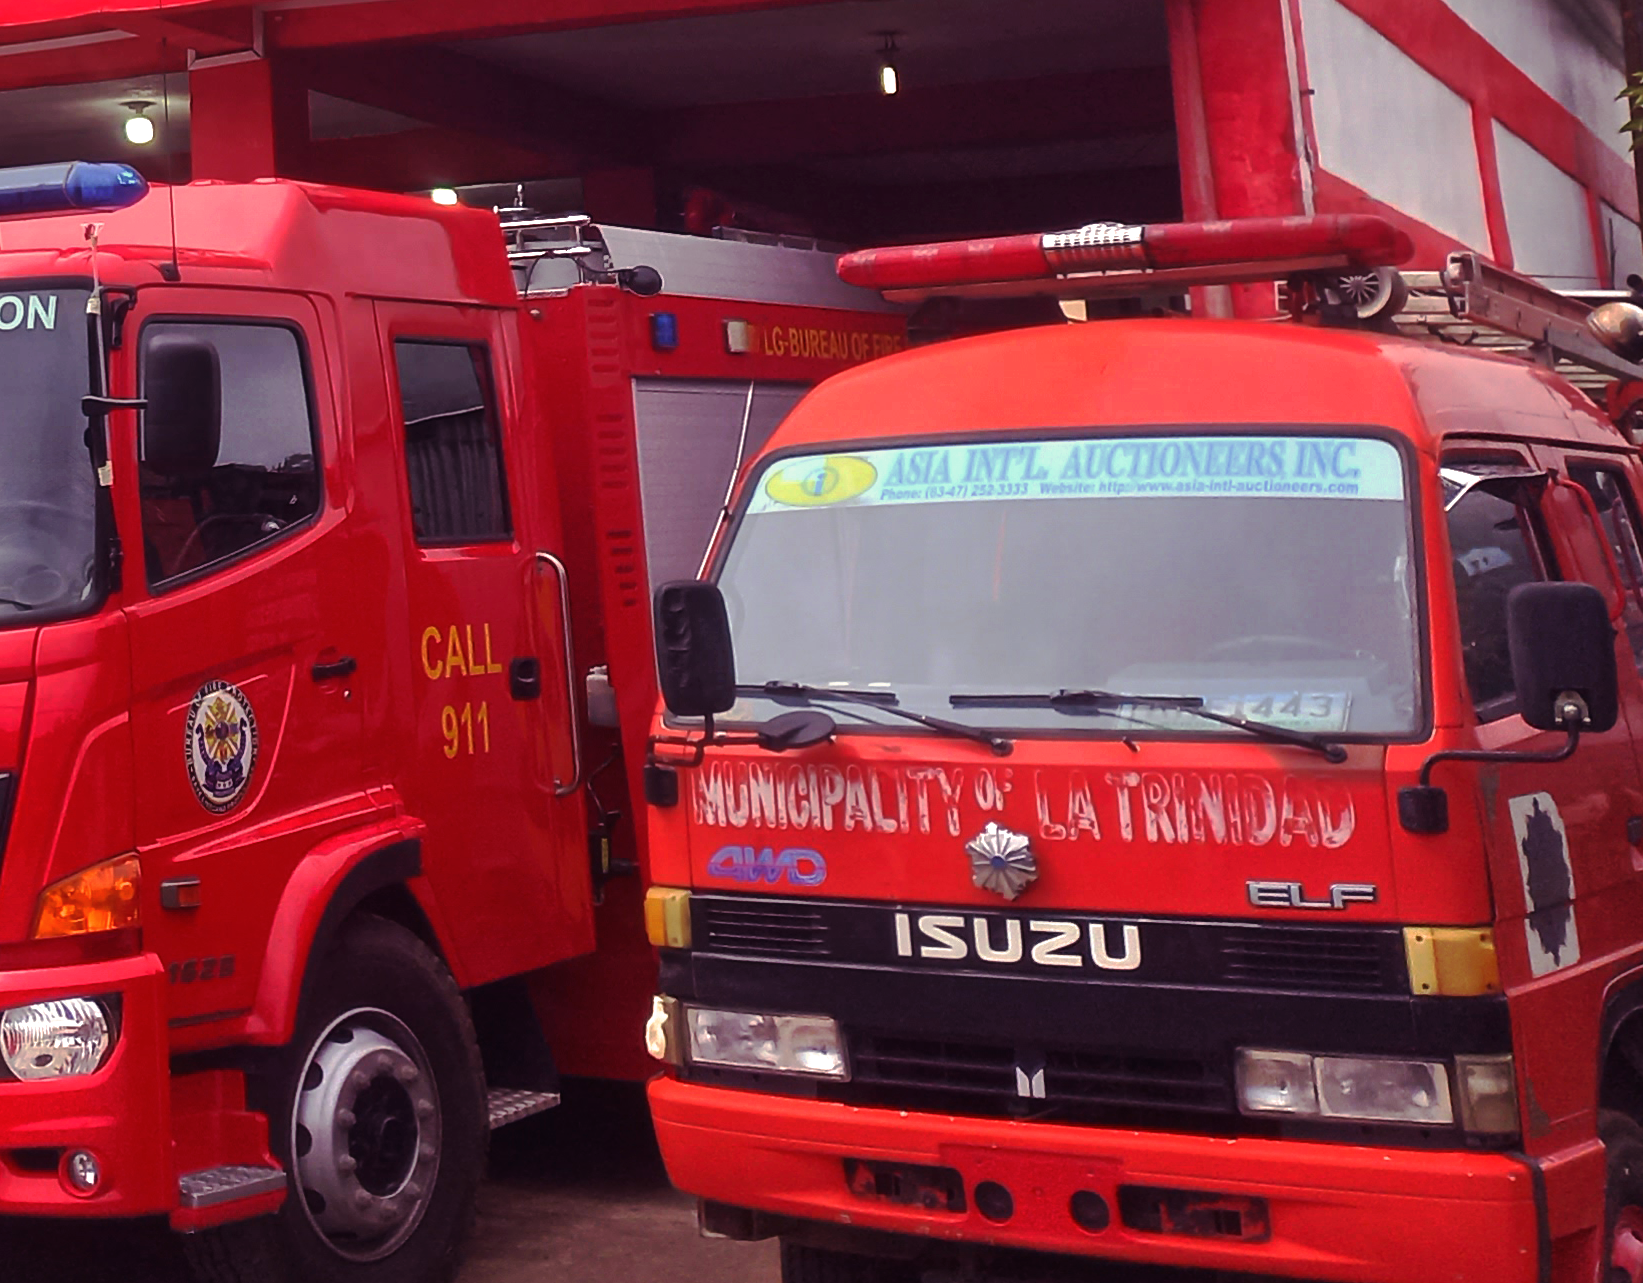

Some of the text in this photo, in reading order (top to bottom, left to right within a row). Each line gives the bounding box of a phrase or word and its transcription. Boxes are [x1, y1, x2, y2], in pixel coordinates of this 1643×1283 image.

[851, 332, 869, 361] OF
[883, 450, 953, 486] ASIA
[1060, 440, 1288, 480] AUCTIONEERS
[880, 488, 922, 501] Phone:
[421, 623, 502, 680] CALL
[442, 701, 489, 759] 911
[691, 761, 964, 836] MUNICIPALITY
[1035, 769, 1101, 841] LA
[1105, 771, 1356, 849] TRINIDAD
[708, 845, 827, 886] 4WD
[1246, 881, 1376, 909] ELF
[895, 913, 1142, 970] ISUZU
